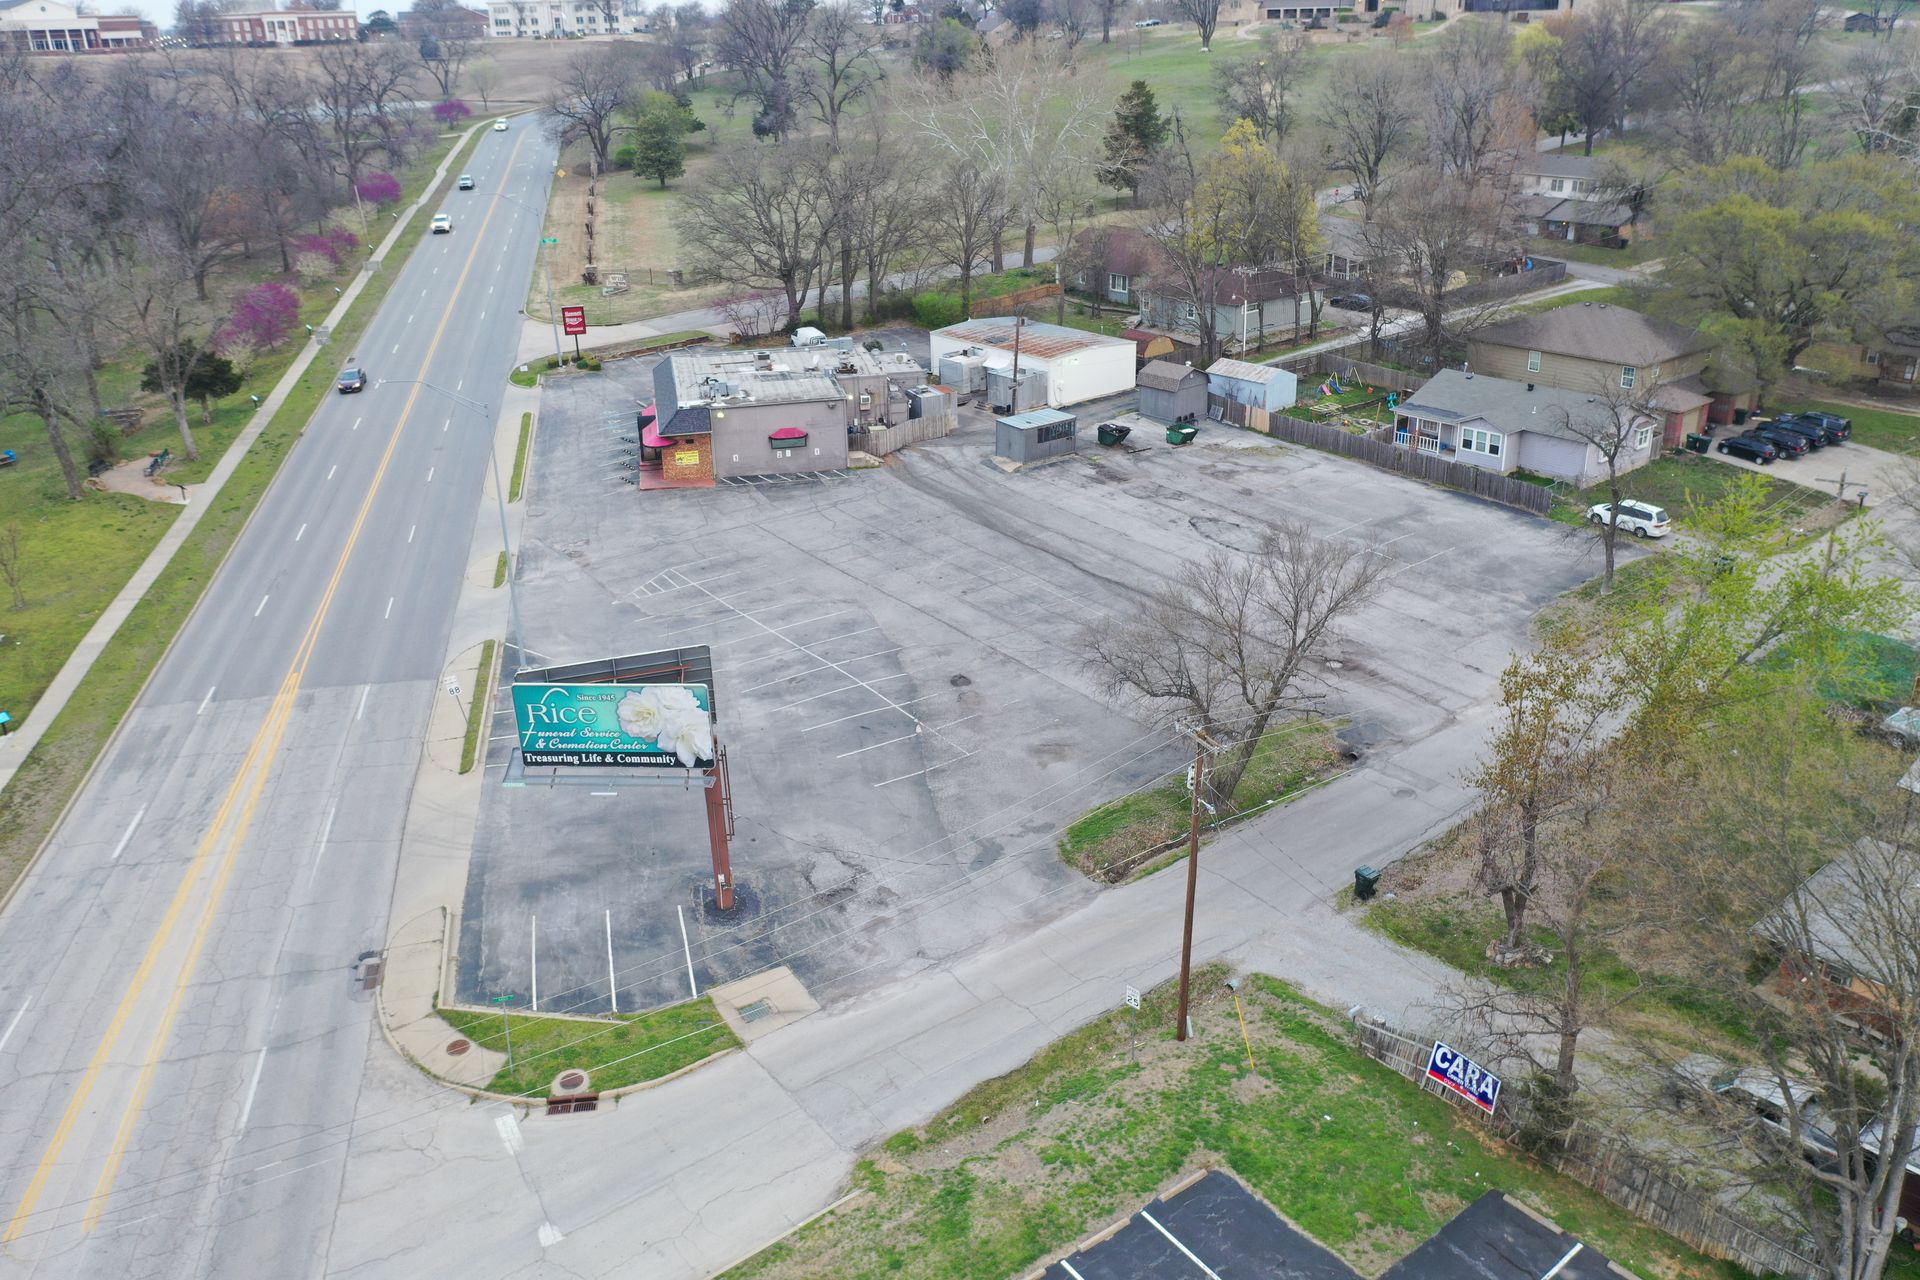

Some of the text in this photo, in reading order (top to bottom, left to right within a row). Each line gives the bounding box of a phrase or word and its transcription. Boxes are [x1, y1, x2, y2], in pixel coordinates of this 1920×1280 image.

[449, 687, 460, 695] 88
[526, 702, 597, 724] Rice
[580, 727, 621, 738] Service
[535, 739, 649, 750] & Cremation Center
[524, 753, 676, 766] Treasuring Life & Community
[1127, 995, 1138, 1007] 25
[1435, 1046, 1494, 1100] CARA
